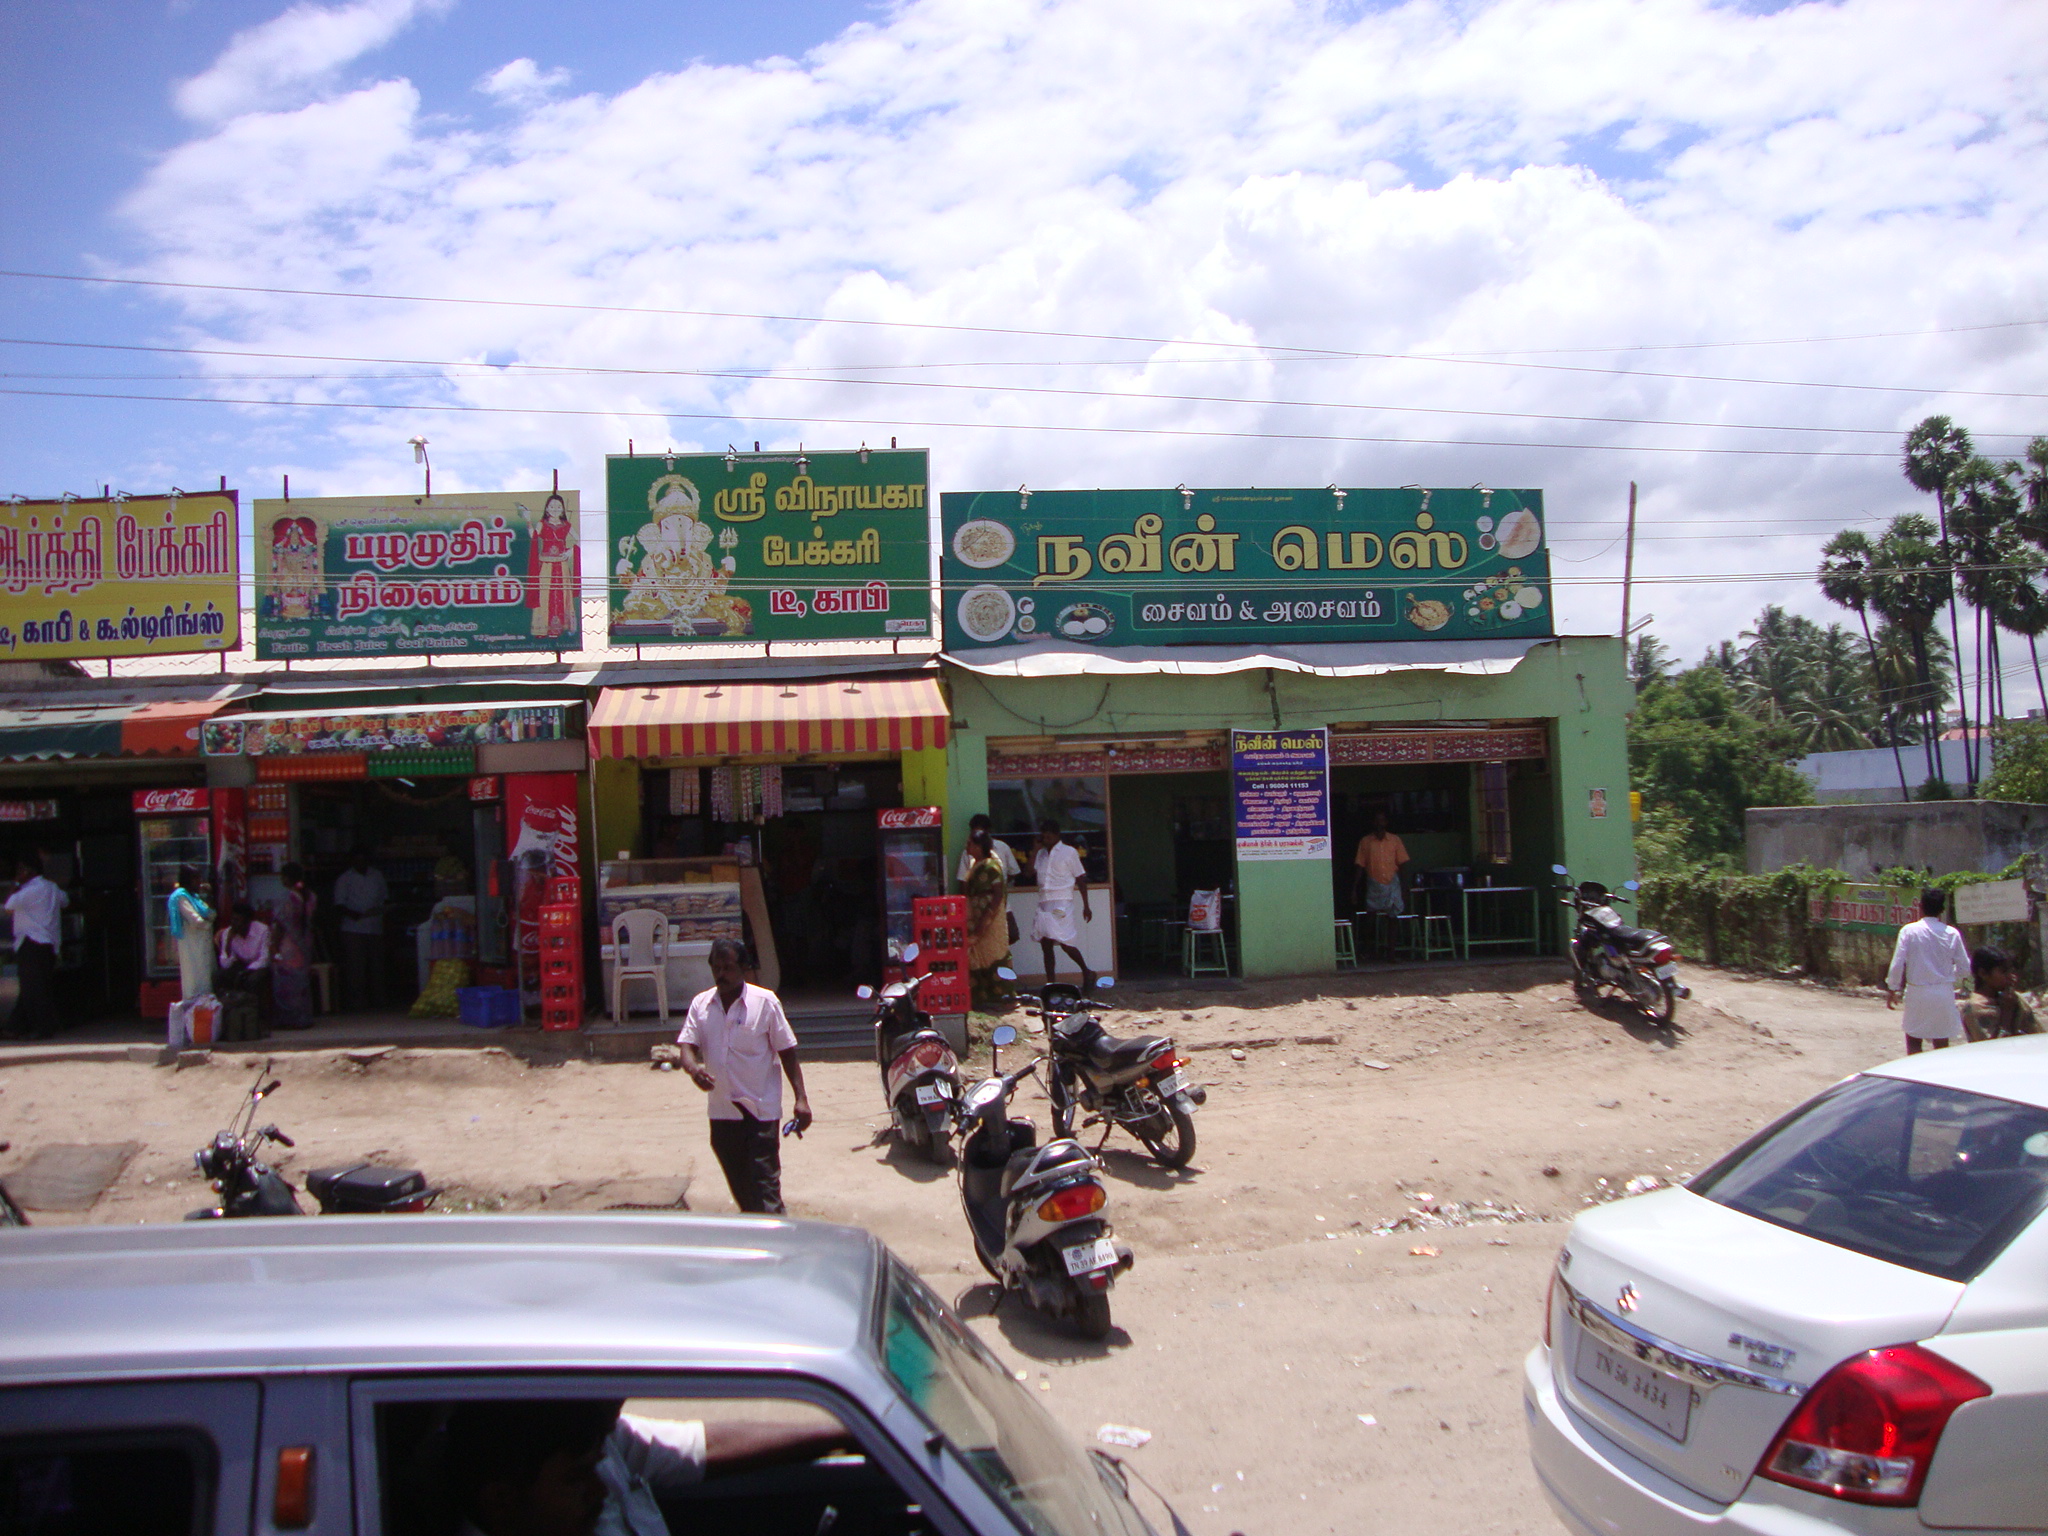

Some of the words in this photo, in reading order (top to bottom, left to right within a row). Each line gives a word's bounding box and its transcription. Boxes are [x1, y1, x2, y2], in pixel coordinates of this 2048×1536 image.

[713, 472, 767, 522] ஸ்ரீ
[775, 475, 926, 522] விநாயகா
[117, 511, 230, 579] பேக்கரி
[344, 516, 516, 571] பழமுதிர்
[763, 526, 881, 568] பேக்கரி
[1032, 513, 1240, 590] நவீன்
[1272, 511, 1469, 572] மெஸ்
[336, 564, 525, 621] நிலையம்
[770, 589, 807, 618] டீ,
[812, 581, 890, 614] காபி
[1142, 593, 1233, 623] சைவம்
[1239, 600, 1258, 621] &
[1262, 591, 1382, 623] அசைவம்
[23, 609, 73, 644] காபி
[79, 619, 91, 641] &
[96, 601, 225, 645] கூல்டிரிங்ஸ்
[272, 643, 309, 653] Fruits
[354, 640, 388, 652] Juice
[425, 638, 469, 649] Drinks
[1281, 733, 1324, 750] மெஸ்
[144, 789, 197, 809] Cocaola
[881, 808, 936, 826] Cocaola
